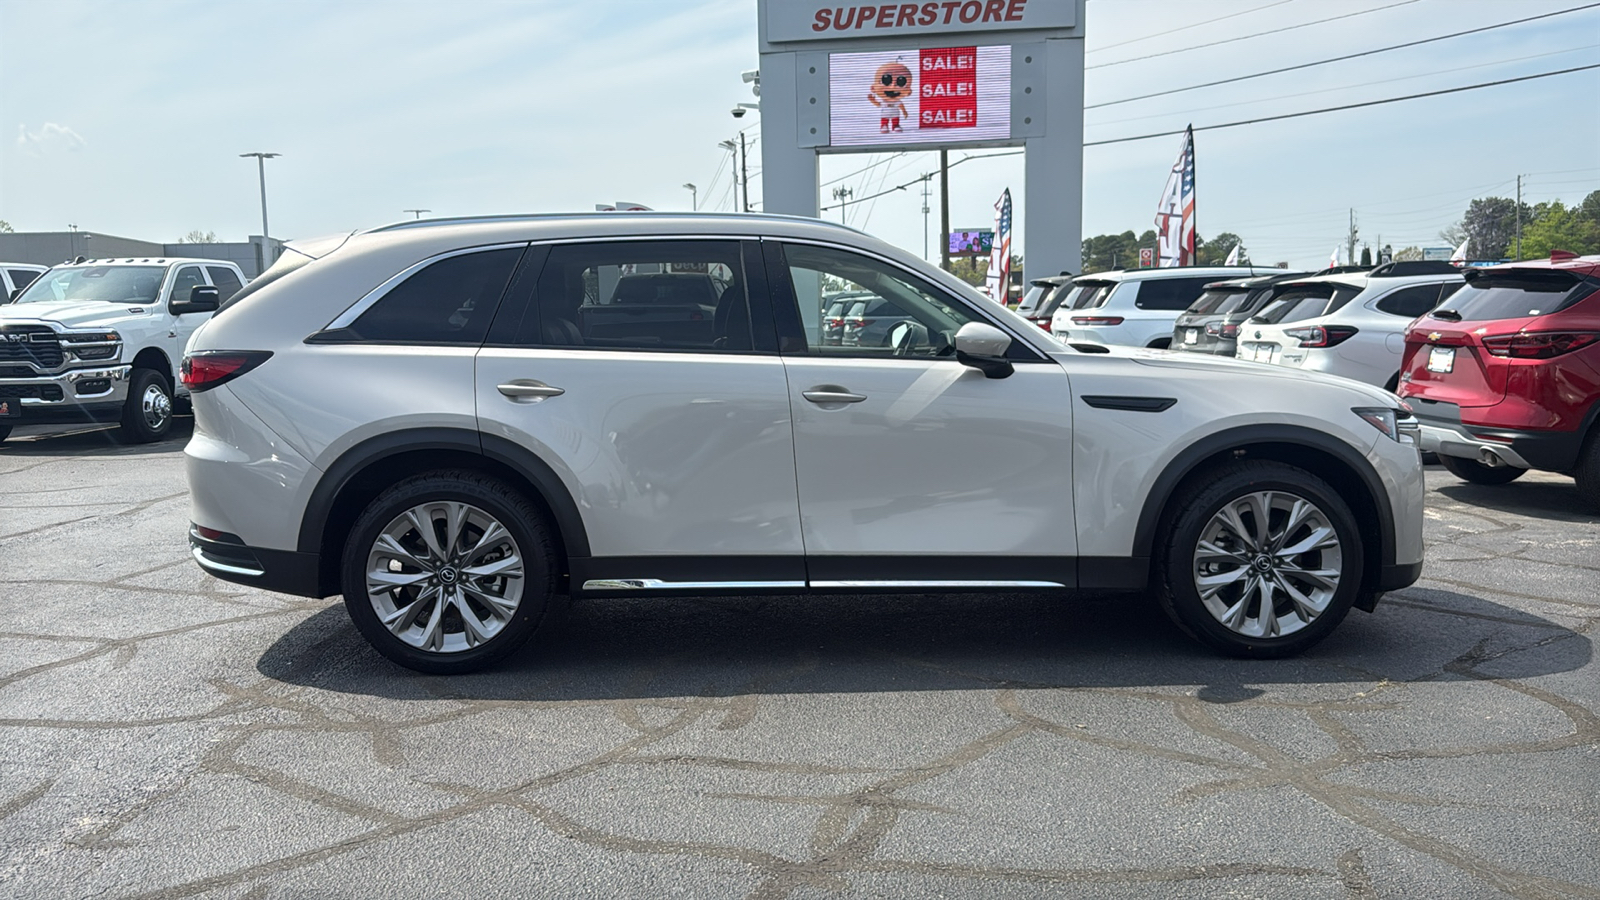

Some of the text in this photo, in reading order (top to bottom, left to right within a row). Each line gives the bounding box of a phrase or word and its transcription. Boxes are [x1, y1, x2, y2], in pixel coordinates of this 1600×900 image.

[813, 0, 1027, 31] SUPERSTORE
[922, 55, 973, 71] SALE!
[922, 82, 973, 97] SALE!
[921, 109, 973, 124] SALE!
